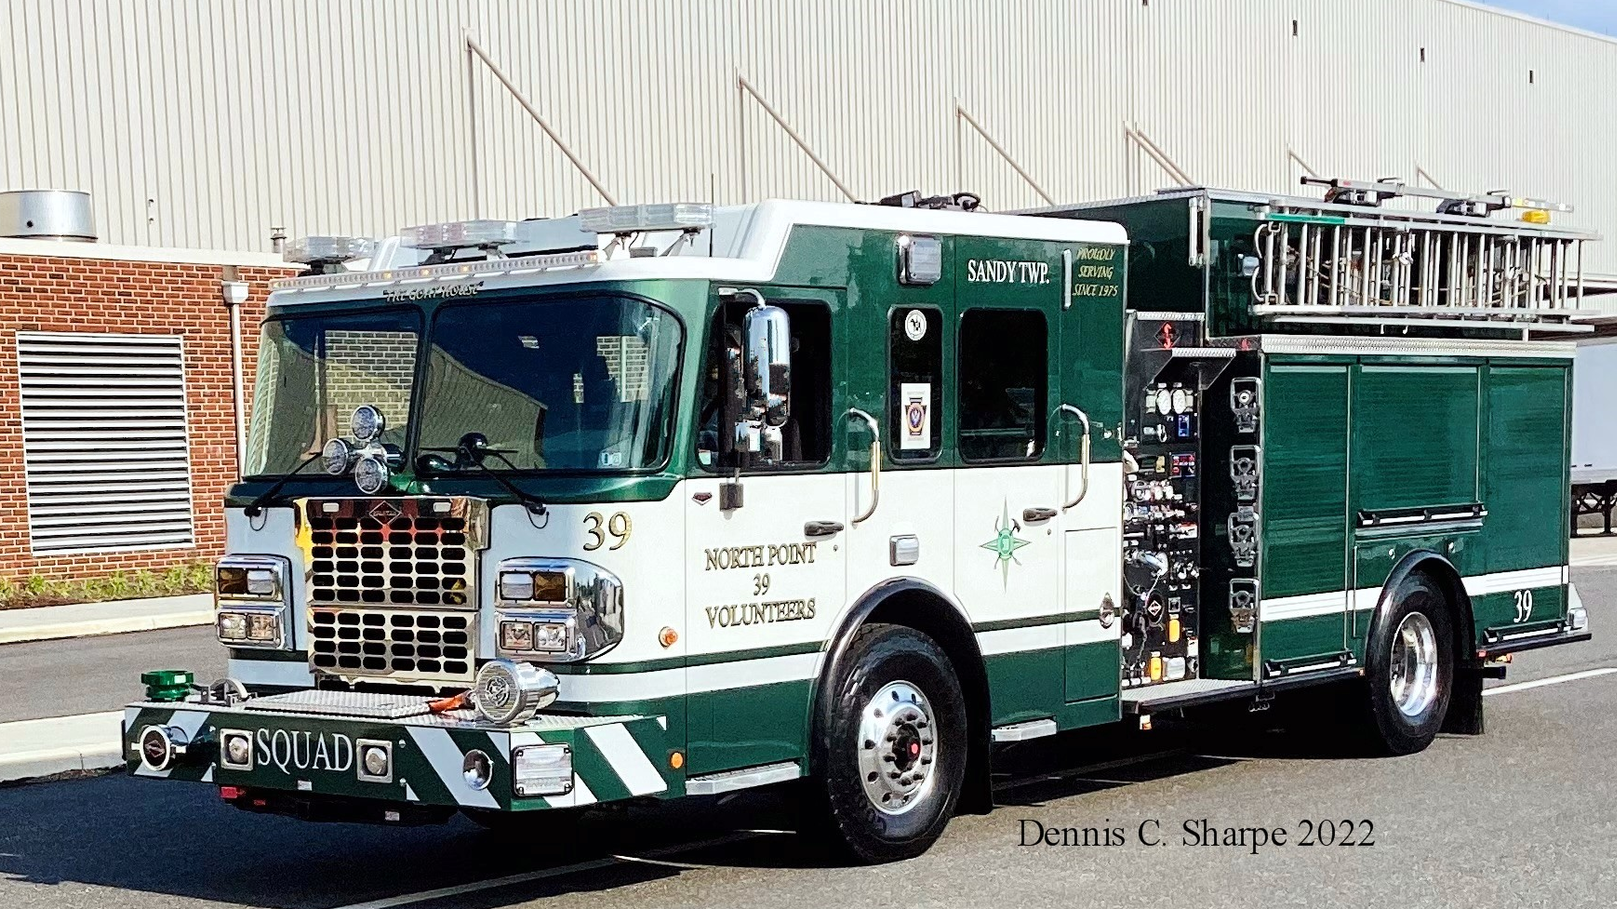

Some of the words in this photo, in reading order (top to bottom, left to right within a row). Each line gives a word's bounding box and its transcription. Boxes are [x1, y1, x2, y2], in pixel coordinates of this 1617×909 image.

[1076, 247, 1116, 261] PROUDLY
[967, 259, 1016, 284] SANDY
[1018, 261, 1050, 284] TWP.
[1078, 265, 1114, 280] SERVING
[1071, 283, 1098, 296] SINCE
[1098, 285, 1119, 297] 1975
[582, 511, 632, 551] 39
[704, 545, 766, 571] NORTH
[767, 541, 817, 566] POINT
[752, 573, 771, 596] 39
[705, 598, 816, 629] VOLUNTEERS
[1513, 589, 1533, 623] 39
[256, 727, 353, 775] SQUAD
